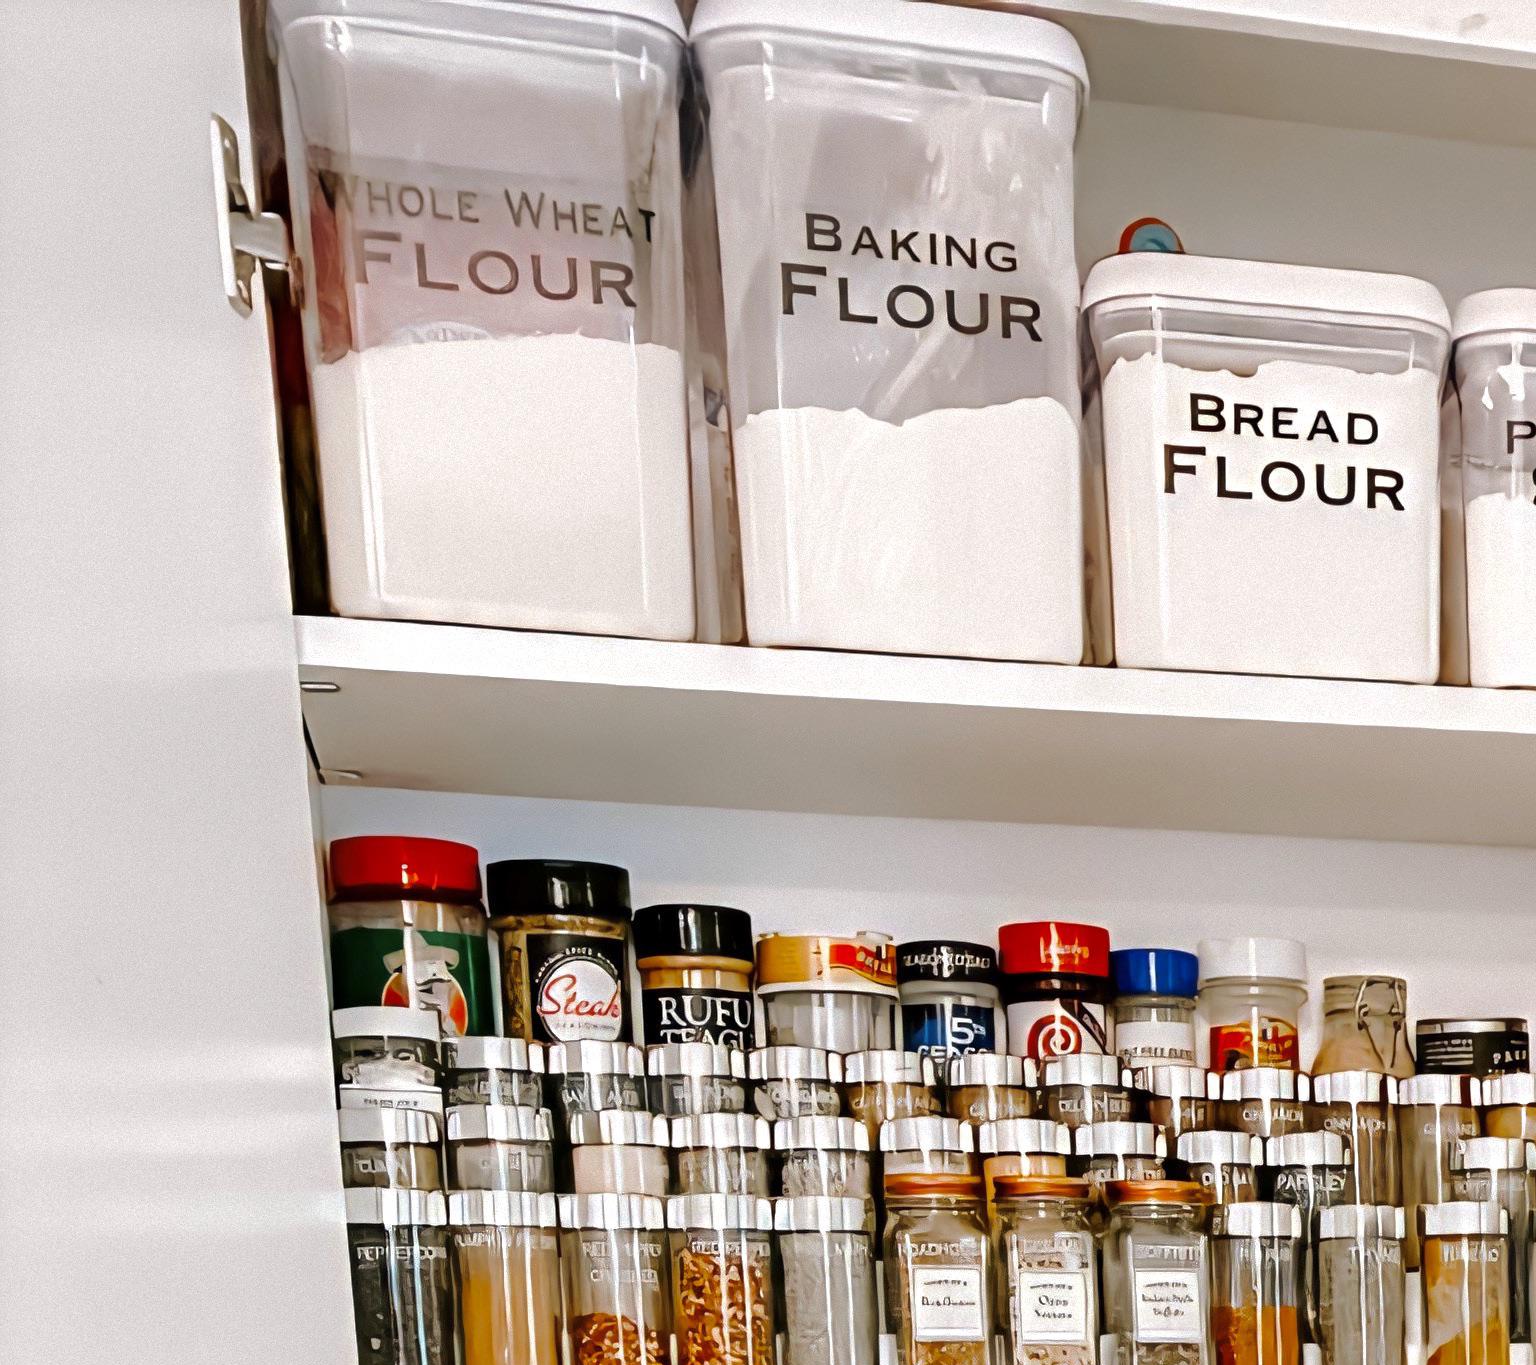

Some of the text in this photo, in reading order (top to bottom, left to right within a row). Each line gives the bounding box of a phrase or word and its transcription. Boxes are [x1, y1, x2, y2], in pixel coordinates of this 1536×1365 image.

[504, 188, 656, 243] WHEAT
[804, 212, 1019, 274] BAKING
[356, 229, 638, 307] FLOUR
[780, 262, 1043, 342] FLOUR
[1189, 392, 1379, 446] BREAD
[1162, 443, 1405, 511] FLOUR
[537, 974, 621, 1018] Steak
